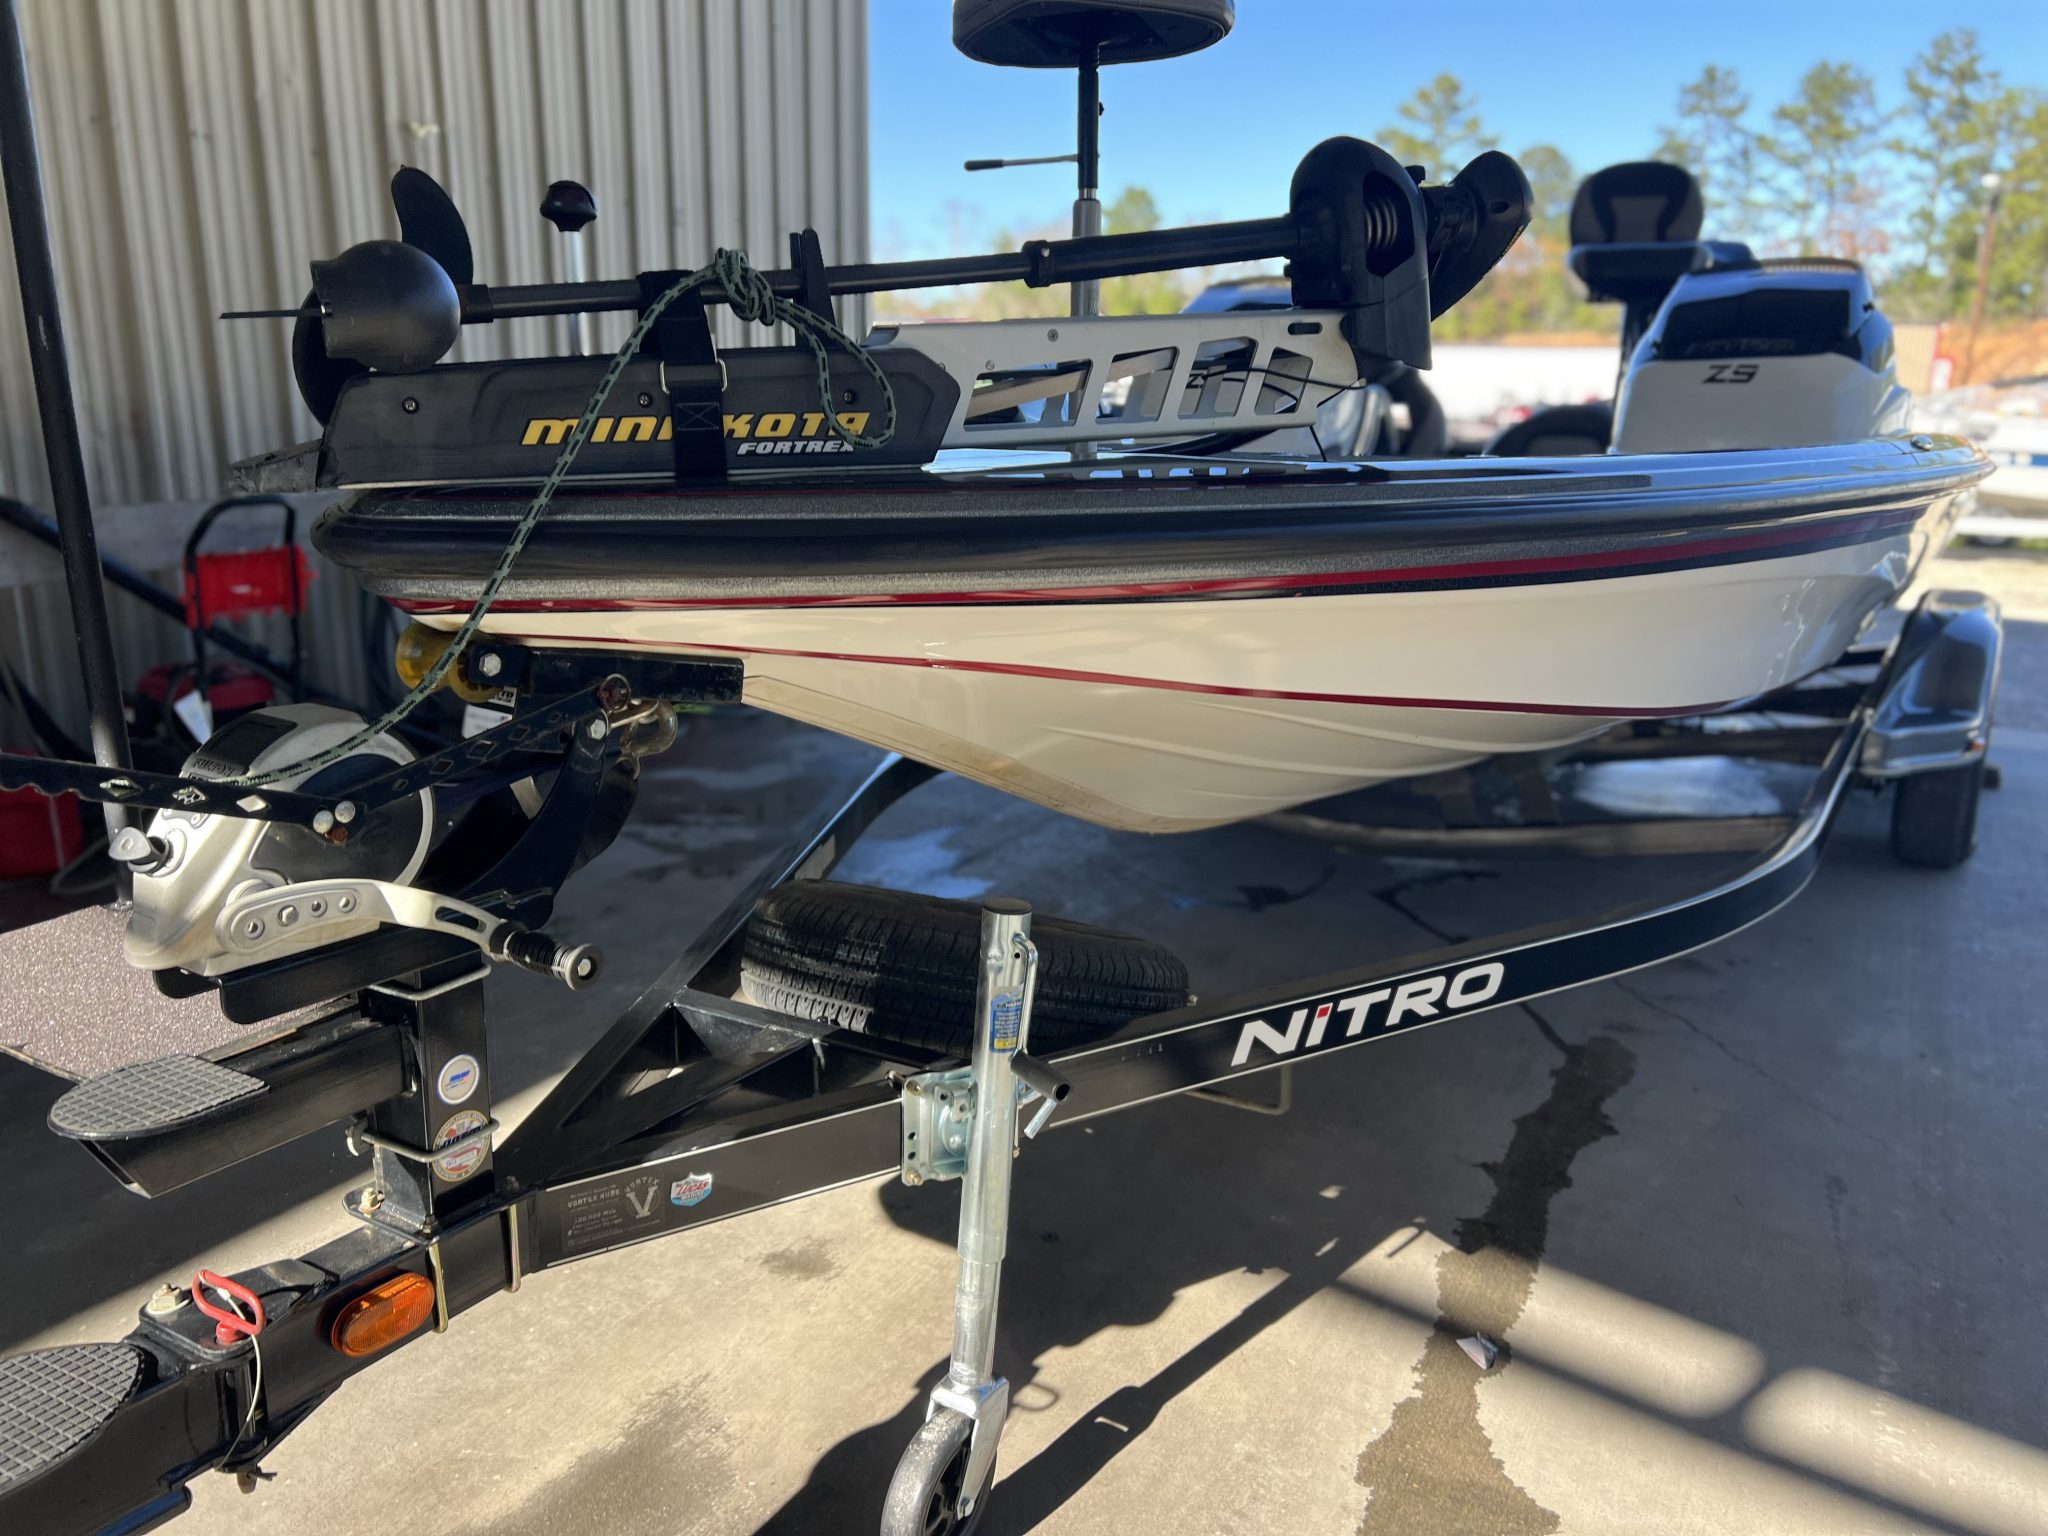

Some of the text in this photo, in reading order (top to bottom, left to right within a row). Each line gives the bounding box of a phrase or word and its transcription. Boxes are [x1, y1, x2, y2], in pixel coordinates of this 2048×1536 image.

[723, 411, 871, 439] KOTA
[736, 440, 855, 456] FORTREX
[1230, 962, 1505, 1067] NITRO
[568, 1194, 597, 1208] VORTEX
